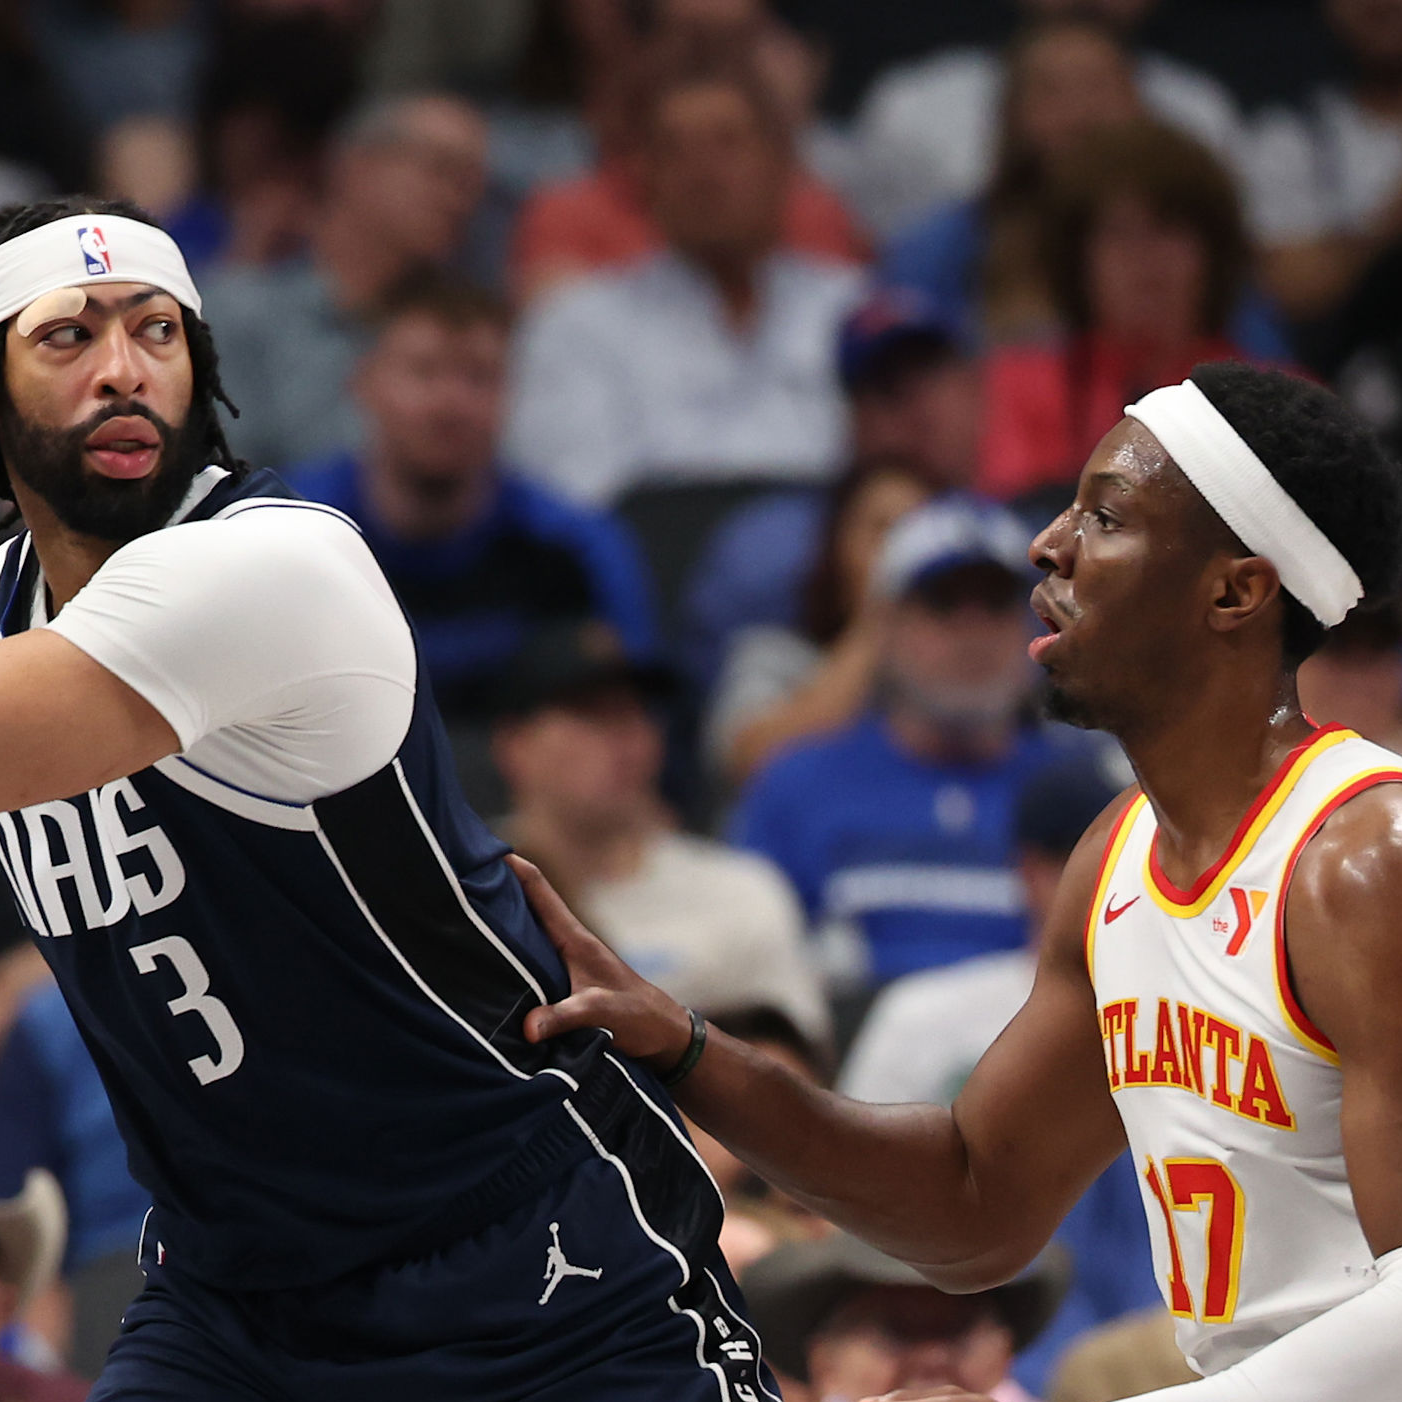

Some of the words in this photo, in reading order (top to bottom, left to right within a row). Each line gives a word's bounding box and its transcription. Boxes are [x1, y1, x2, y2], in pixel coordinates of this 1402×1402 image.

[1212, 916, 1229, 934] the
[1226, 887, 1269, 957] Y
[128, 935, 245, 1086] 3
[1098, 997, 1297, 1132] TLANTA
[1144, 1155, 1245, 1323] 17
